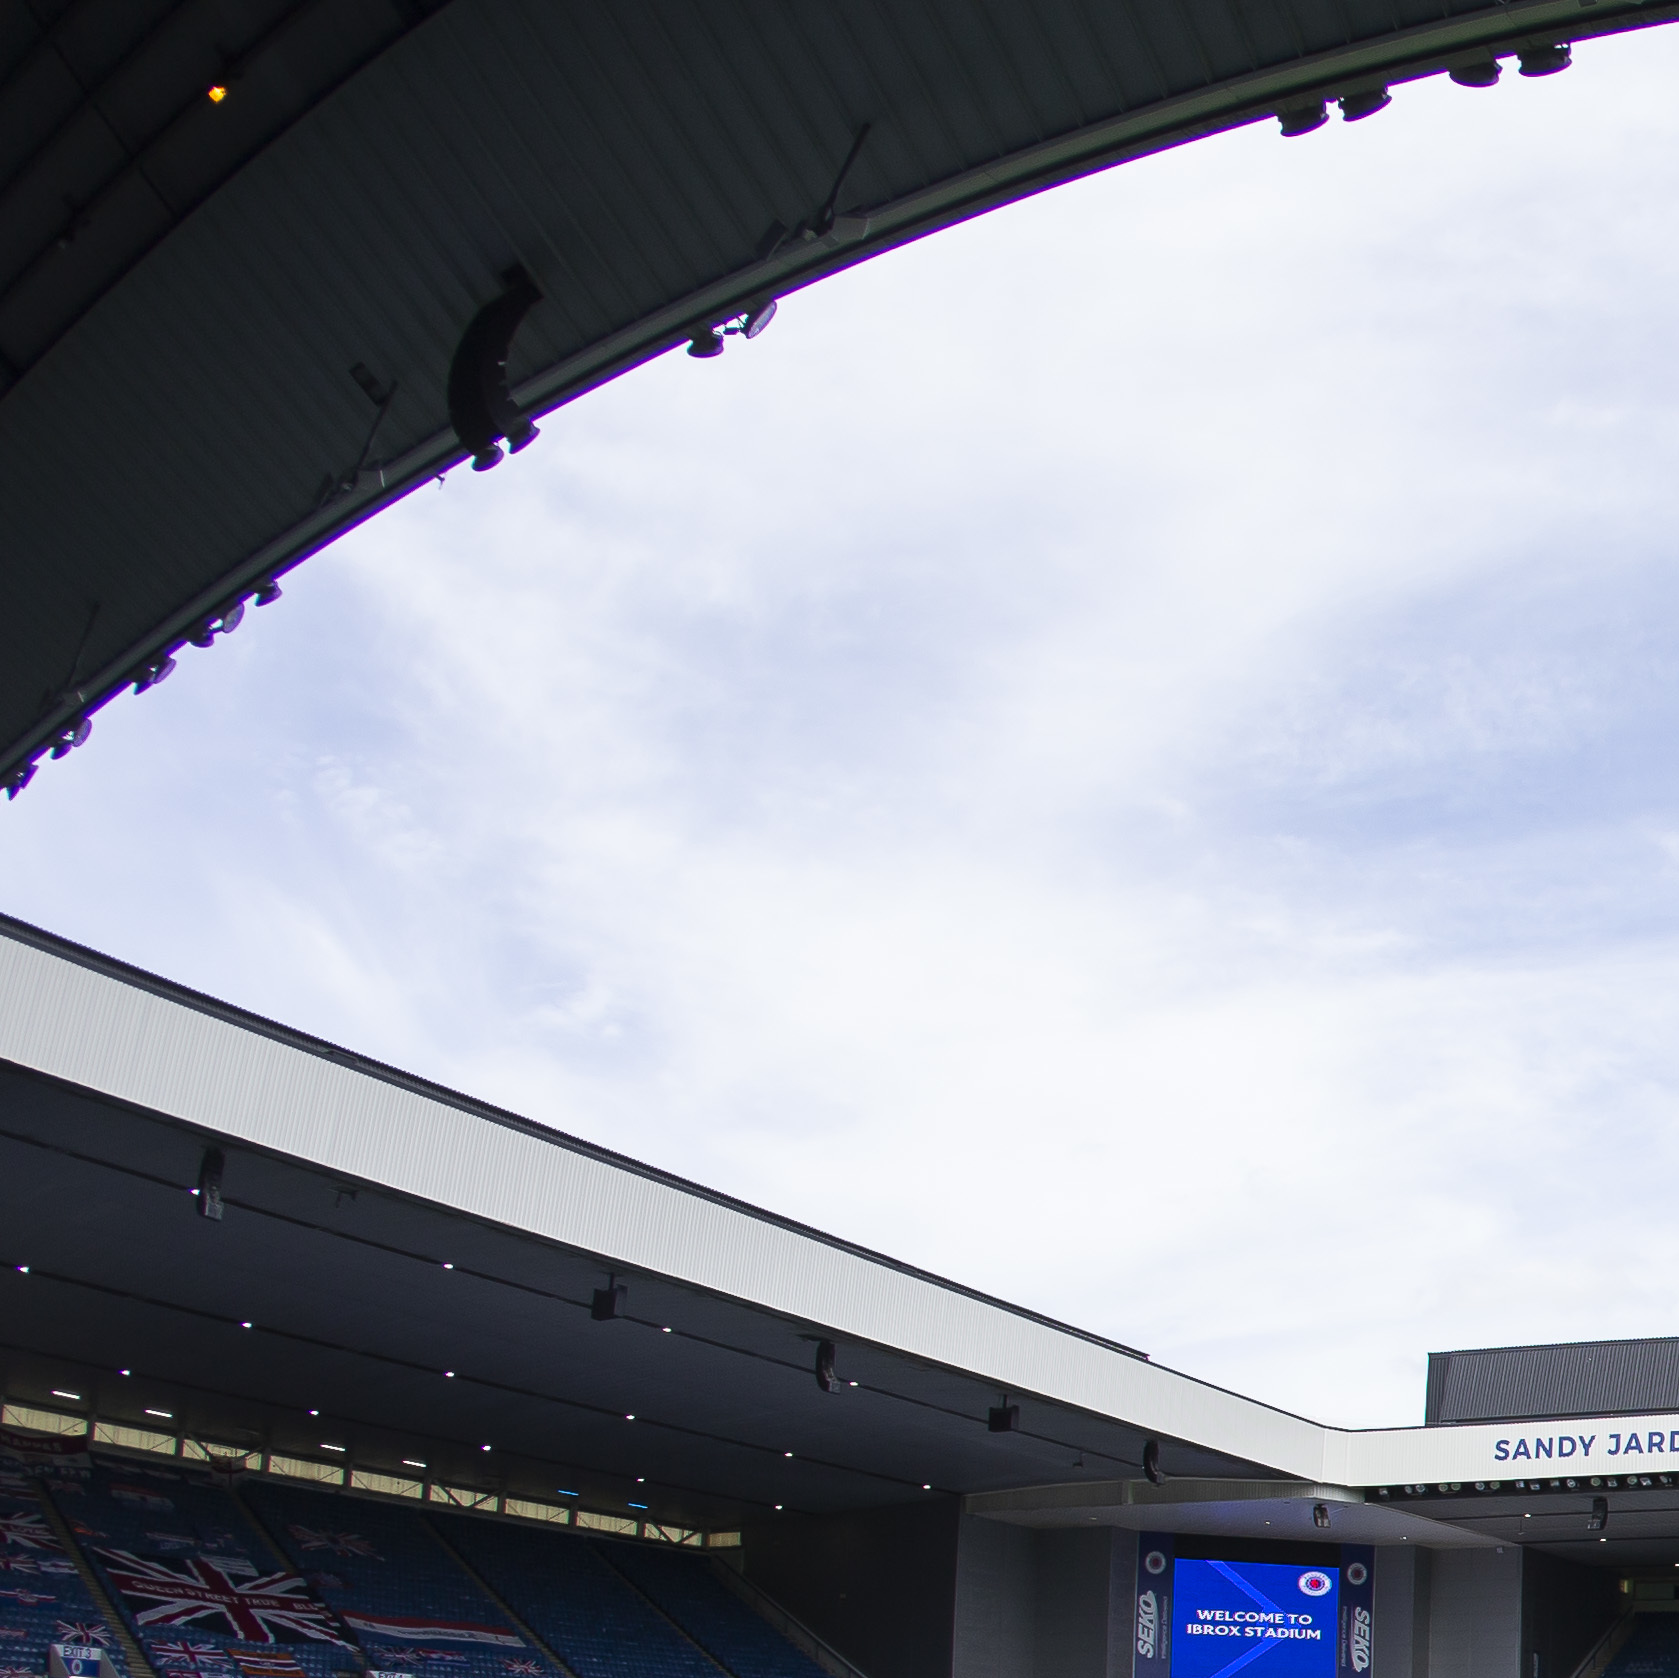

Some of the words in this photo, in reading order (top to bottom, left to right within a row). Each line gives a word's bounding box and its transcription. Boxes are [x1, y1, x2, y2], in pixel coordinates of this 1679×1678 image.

[1494, 1434, 1596, 1461] SANDY
[1197, 1609, 1284, 1624] WELCOME
[1288, 1613, 1313, 1625] TO
[1186, 1623, 1241, 1637] IBROX
[1245, 1626, 1321, 1640] STADIUM
